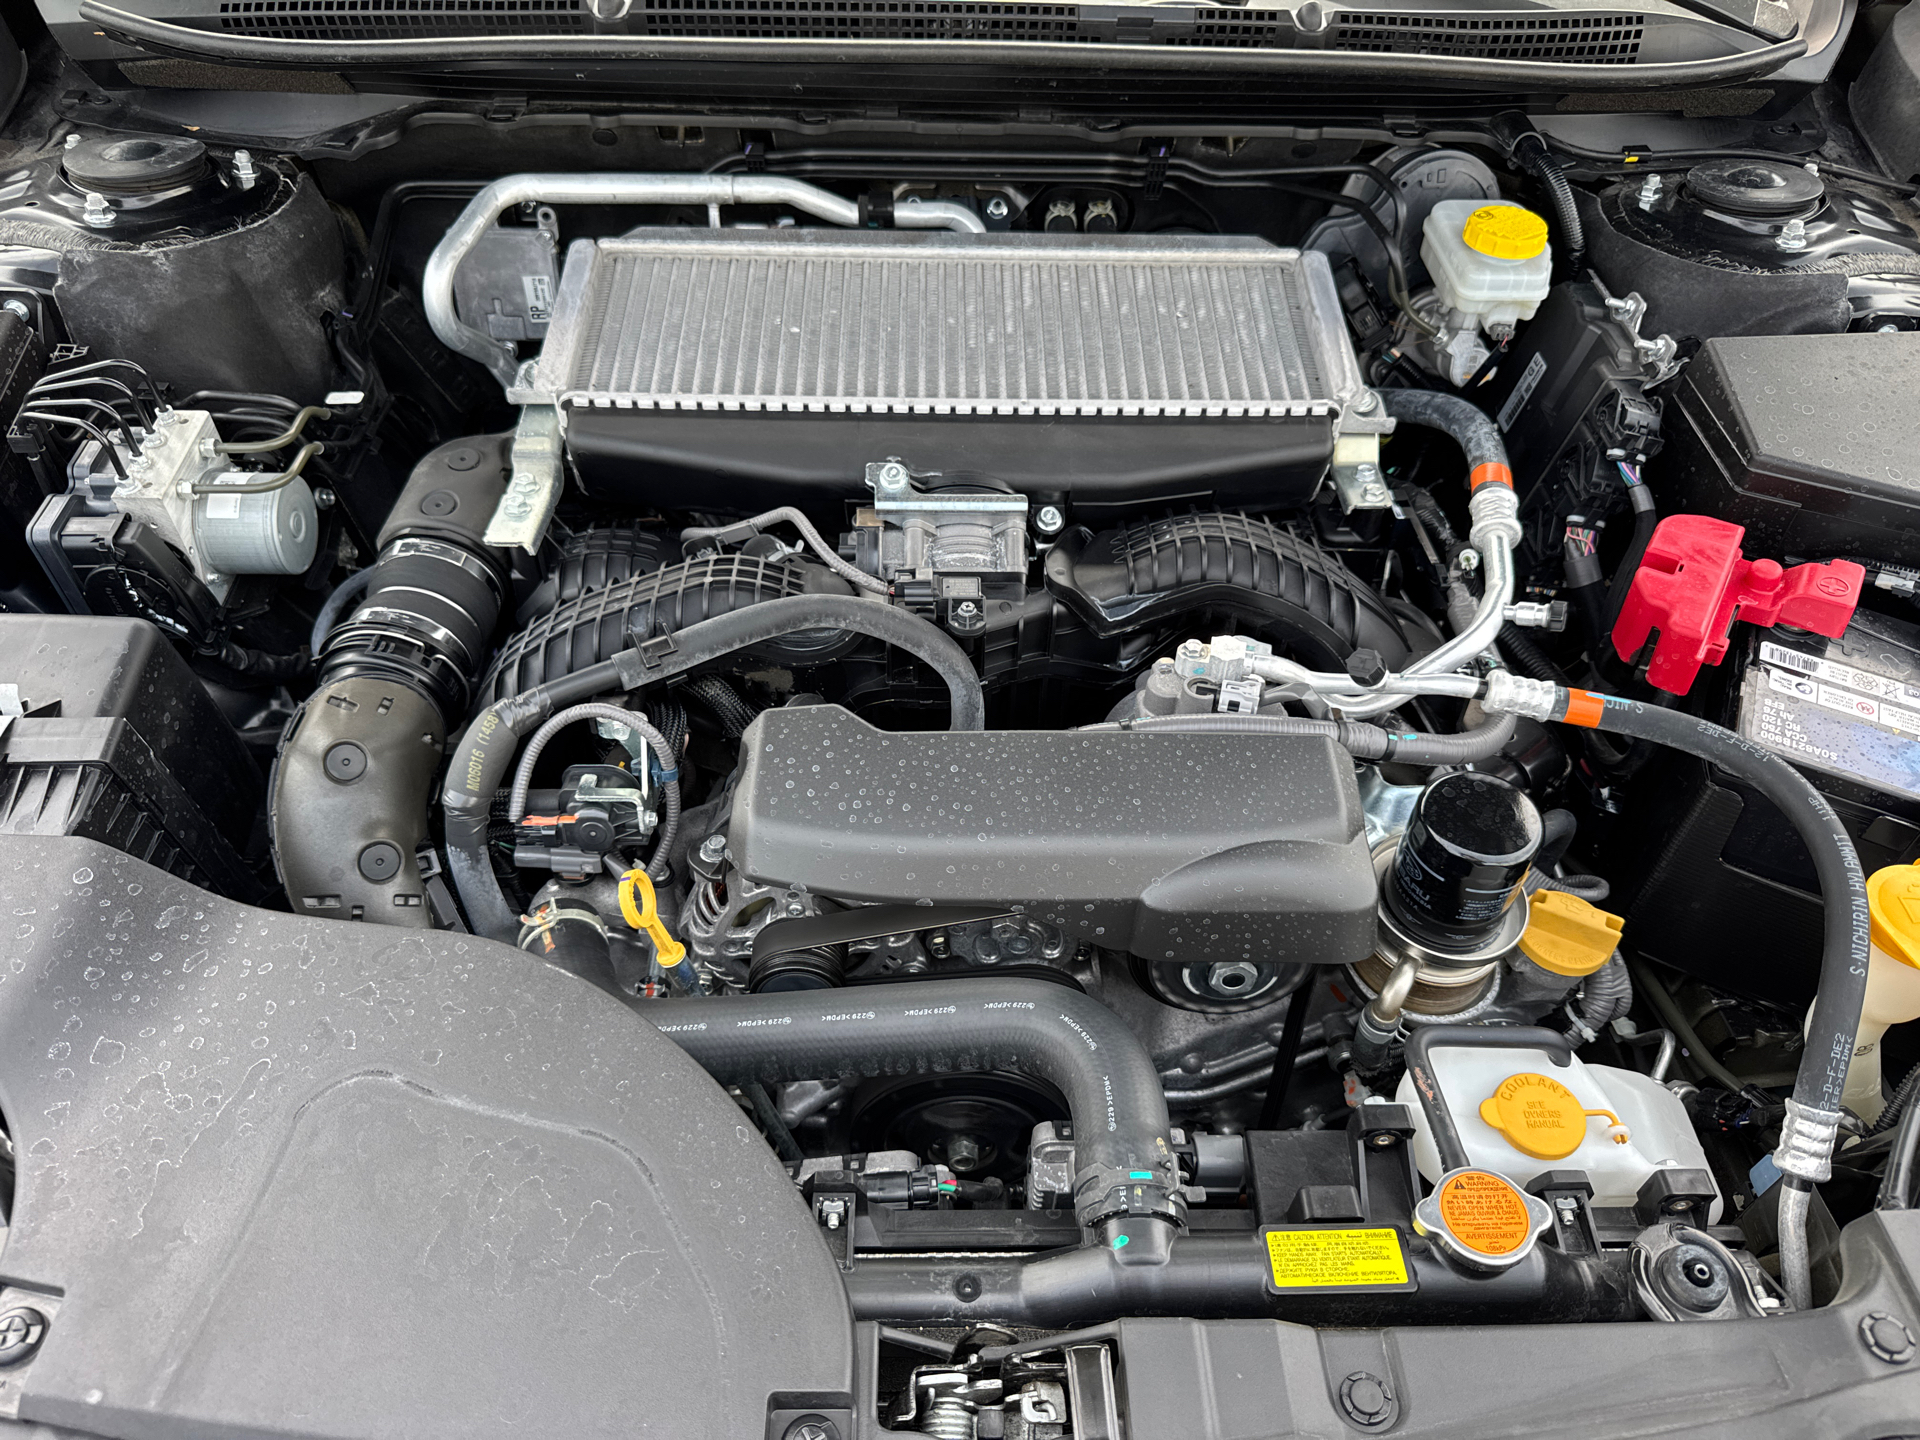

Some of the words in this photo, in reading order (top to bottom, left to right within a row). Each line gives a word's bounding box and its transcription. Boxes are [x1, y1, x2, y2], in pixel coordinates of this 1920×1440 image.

[1764, 698, 1785, 711] EFB
[1763, 705, 1777, 716] 76
[1779, 710, 1795, 721] Ah
[1762, 713, 1783, 726] 120
[1761, 722, 1782, 735] 750
[1785, 721, 1801, 732] RC
[1784, 729, 1808, 743] CCA
[466, 748, 485, 792] M06016
[476, 711, 500, 746] (1458)
[934, 1007, 950, 1015] 229
[683, 1023, 699, 1032] 229
[767, 1018, 783, 1026] 229
[1080, 1031, 1093, 1045] 229
[1820, 1033, 1846, 1111] 2-D-F-DE2
[1500, 1075, 1571, 1102] COOLANT
[1526, 1100, 1547, 1110] SEE
[1107, 1106, 1115, 1125] 229
[1526, 1119, 1566, 1129] MANUAL
[1293, 1233, 1315, 1241] CAUTION
[1316, 1233, 1343, 1241] ATTENTION
[1465, 1232, 1518, 1240] AVERTISSEMENT
